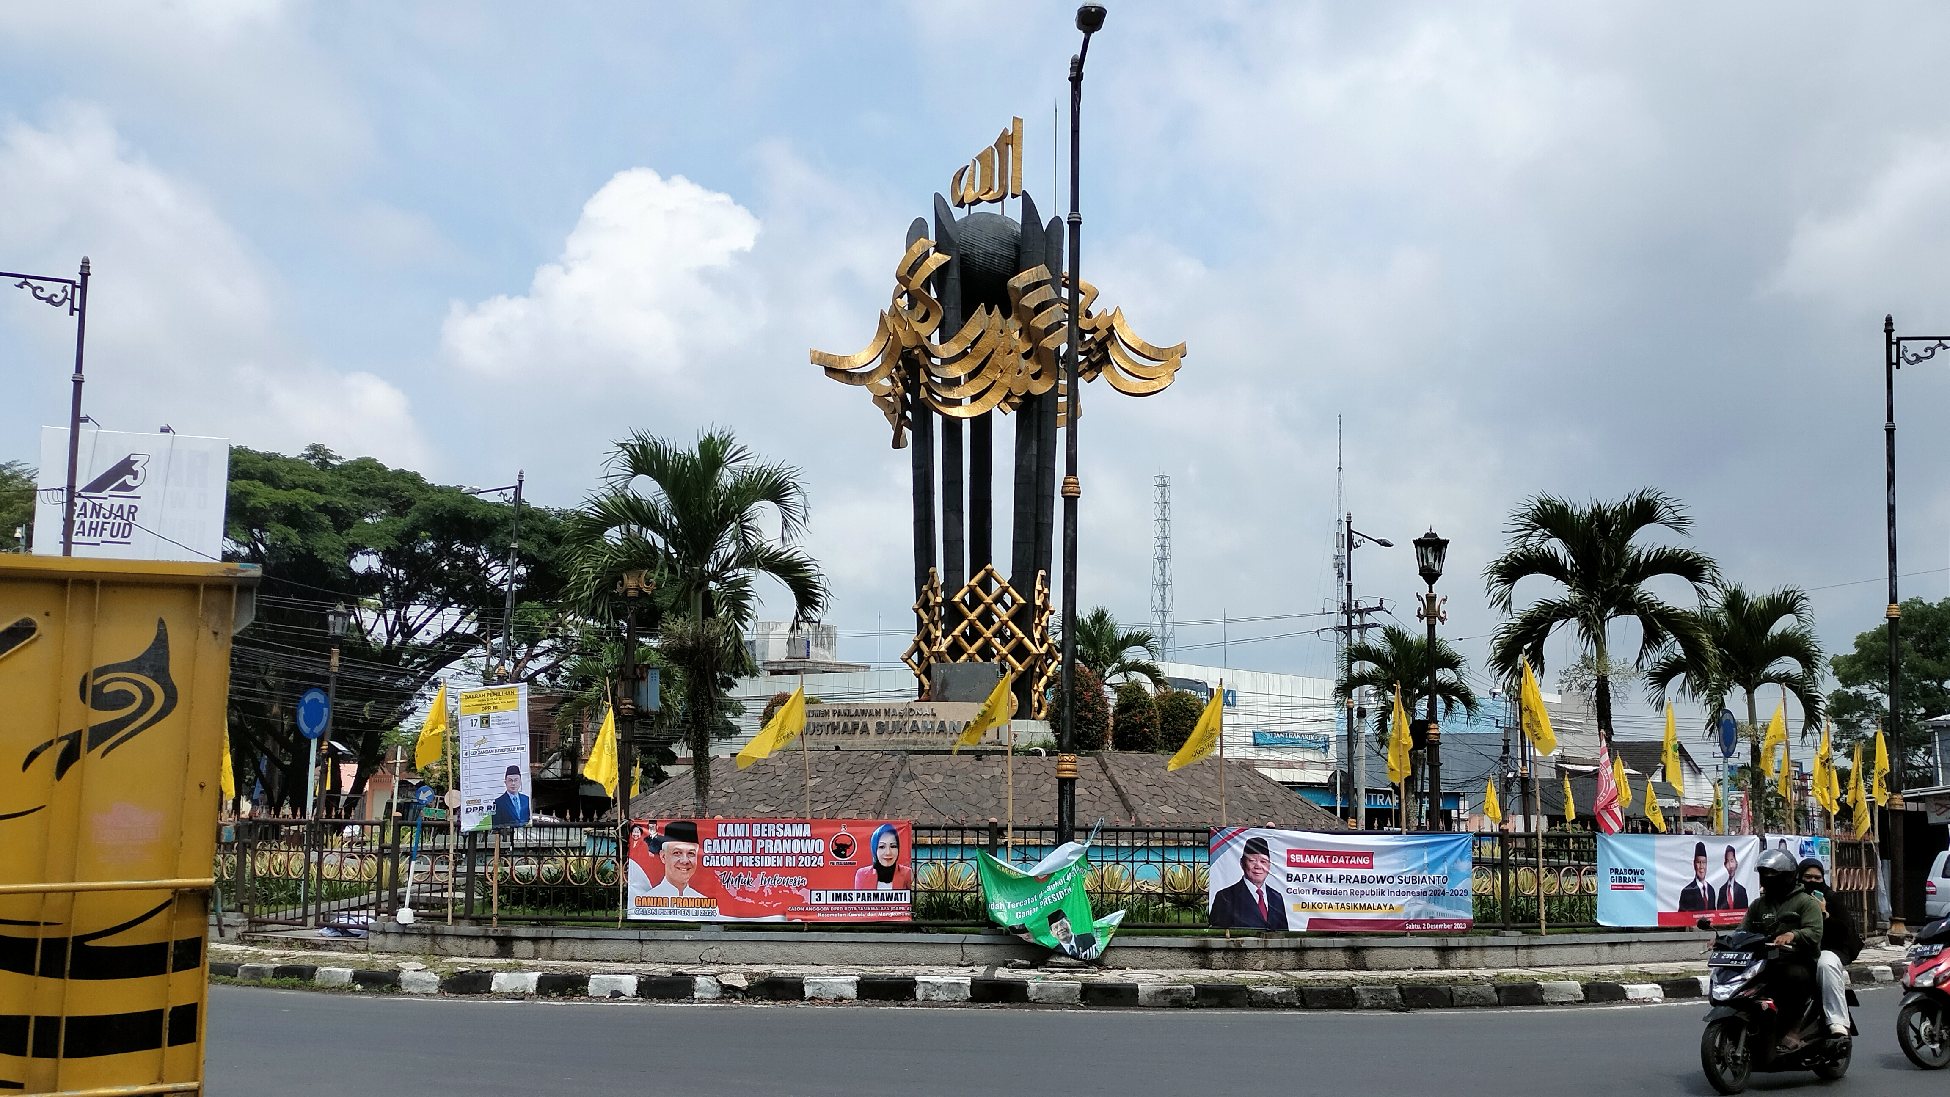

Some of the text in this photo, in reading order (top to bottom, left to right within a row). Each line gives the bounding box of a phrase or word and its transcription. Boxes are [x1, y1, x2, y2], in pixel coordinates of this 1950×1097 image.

[125, 453, 150, 488] 3
[73, 501, 138, 521] ANJAR
[62, 520, 133, 539] AHFUD
[470, 718, 478, 728] 17
[465, 806, 485, 814] DPR
[718, 823, 812, 838] KAMI BERSAMA
[703, 838, 824, 854] GANJAR PRANOWO
[702, 855, 824, 868] CALON PRESIDEN RI 2024
[1290, 854, 1370, 864] SELAMAT DATANG
[1610, 868, 1645, 876] PRABOWO
[719, 871, 808, 889] Untuk Indonesia
[1286, 873, 1448, 884] BAPAK H. PRABOWO SUBIANTO
[815, 892, 822, 902] 3
[832, 892, 907, 902] IMAS PARMAWATI
[1312, 888, 1348, 896] Presiden
[1350, 888, 1386, 898] Republik
[1388, 888, 1428, 896] Indonesia
[1428, 888, 1469, 897] 2024-2029
[635, 896, 718, 908] GANJAR PRANOWO
[1006, 892, 1038, 910] Tercatat
[1301, 902, 1394, 910] DI KOTA TASIKMALAYA
[1016, 906, 1039, 920] Ganjar
